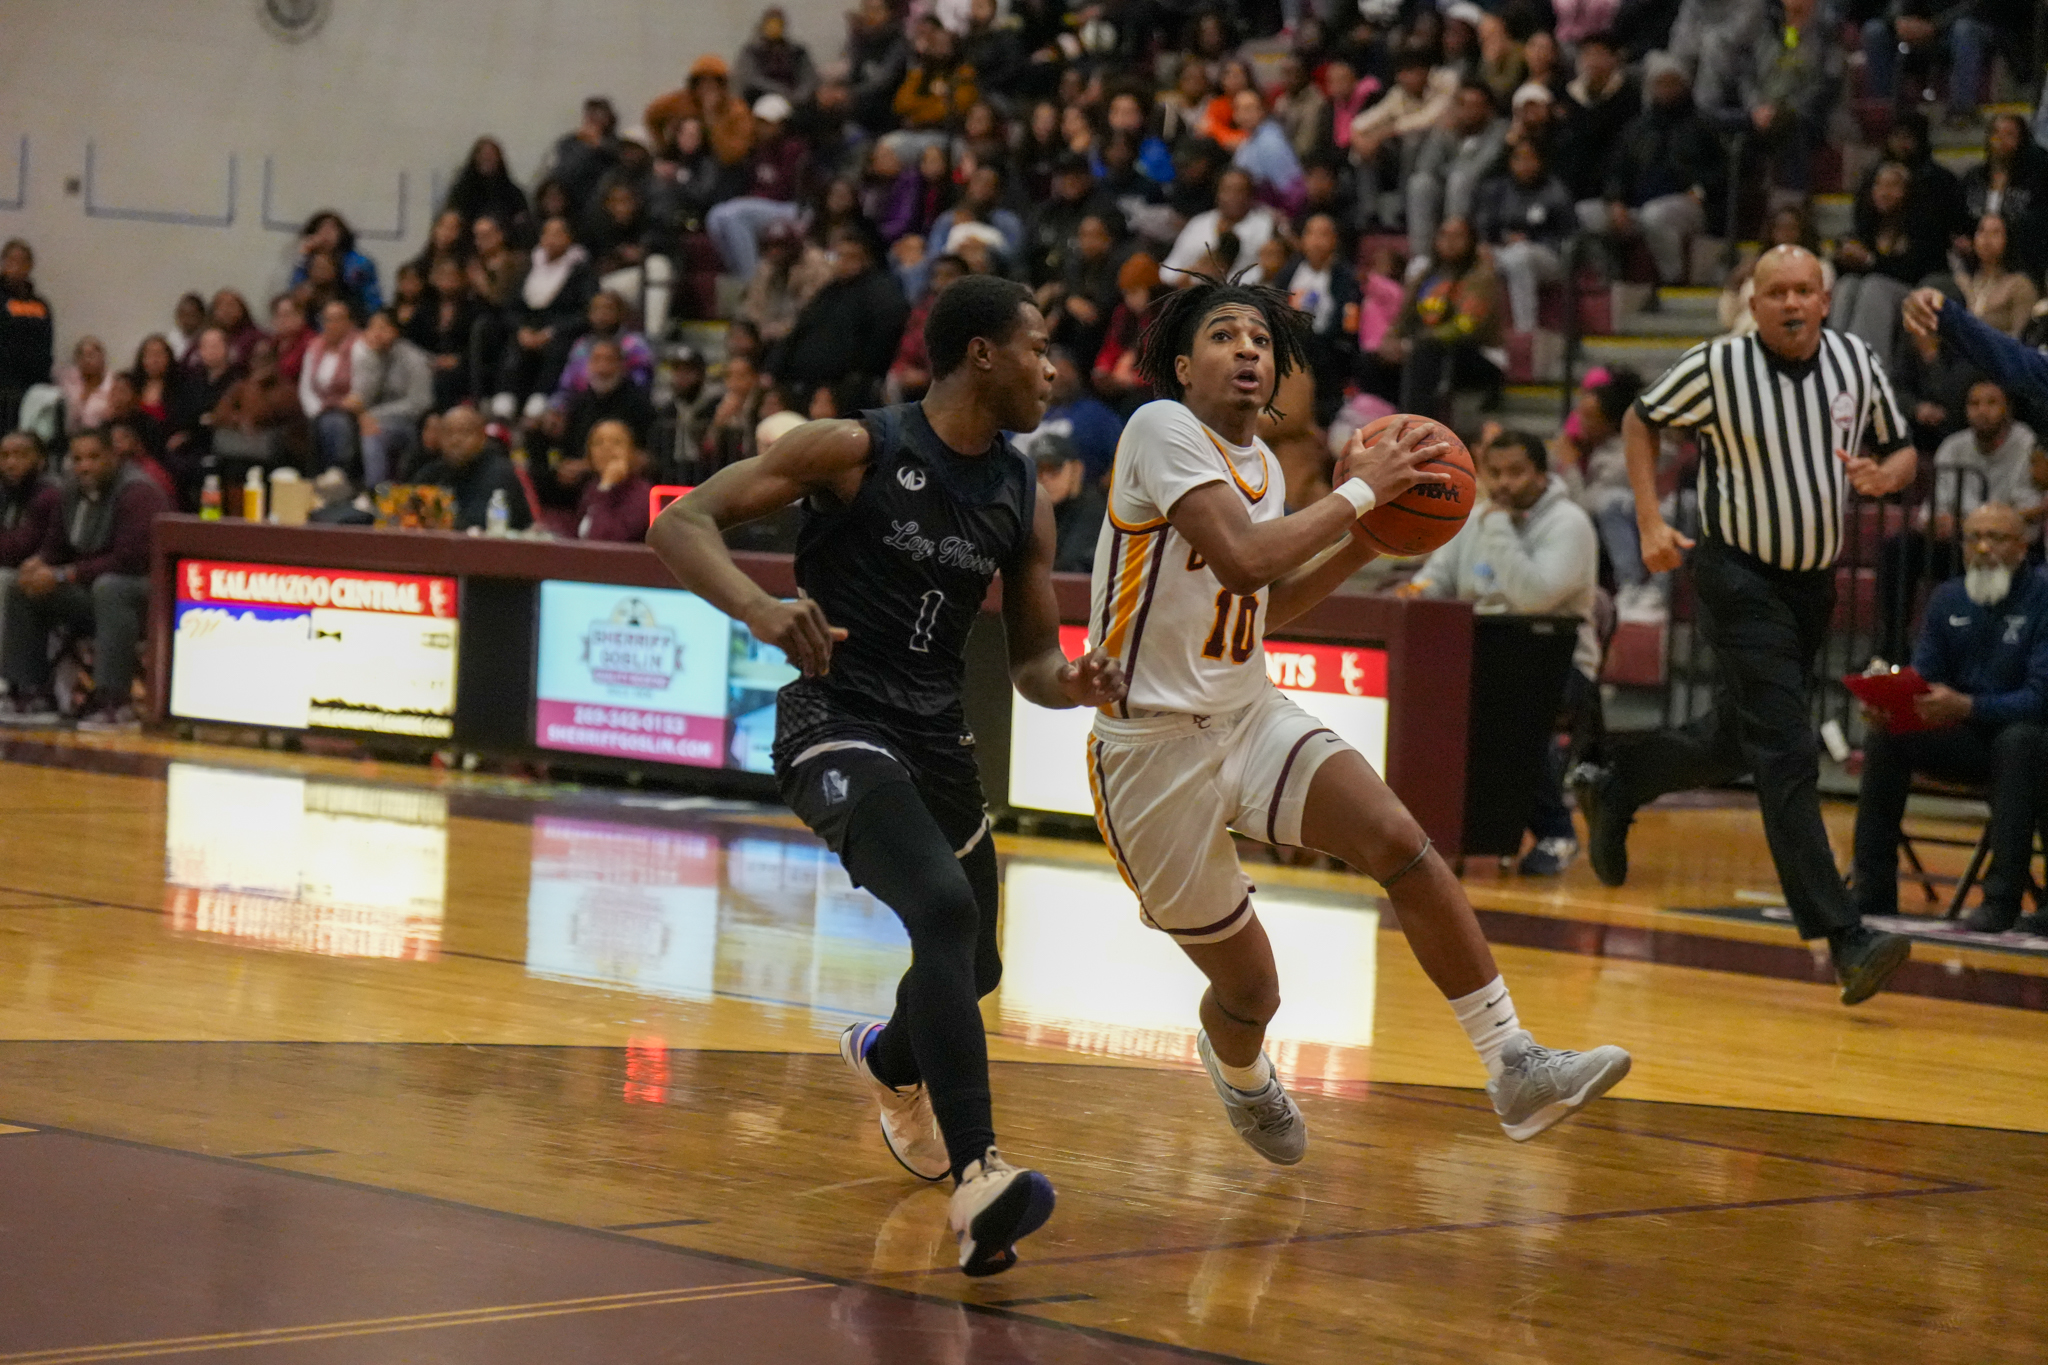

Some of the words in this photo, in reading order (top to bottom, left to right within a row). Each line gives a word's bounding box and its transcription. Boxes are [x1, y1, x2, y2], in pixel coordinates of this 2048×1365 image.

[883, 519, 935, 561] Loy
[209, 568, 331, 607] KALAMAZOO
[331, 577, 425, 614] CENTRAL
[909, 589, 945, 653] 1
[1201, 587, 1260, 665] 10
[1265, 651, 1317, 688] NTS
